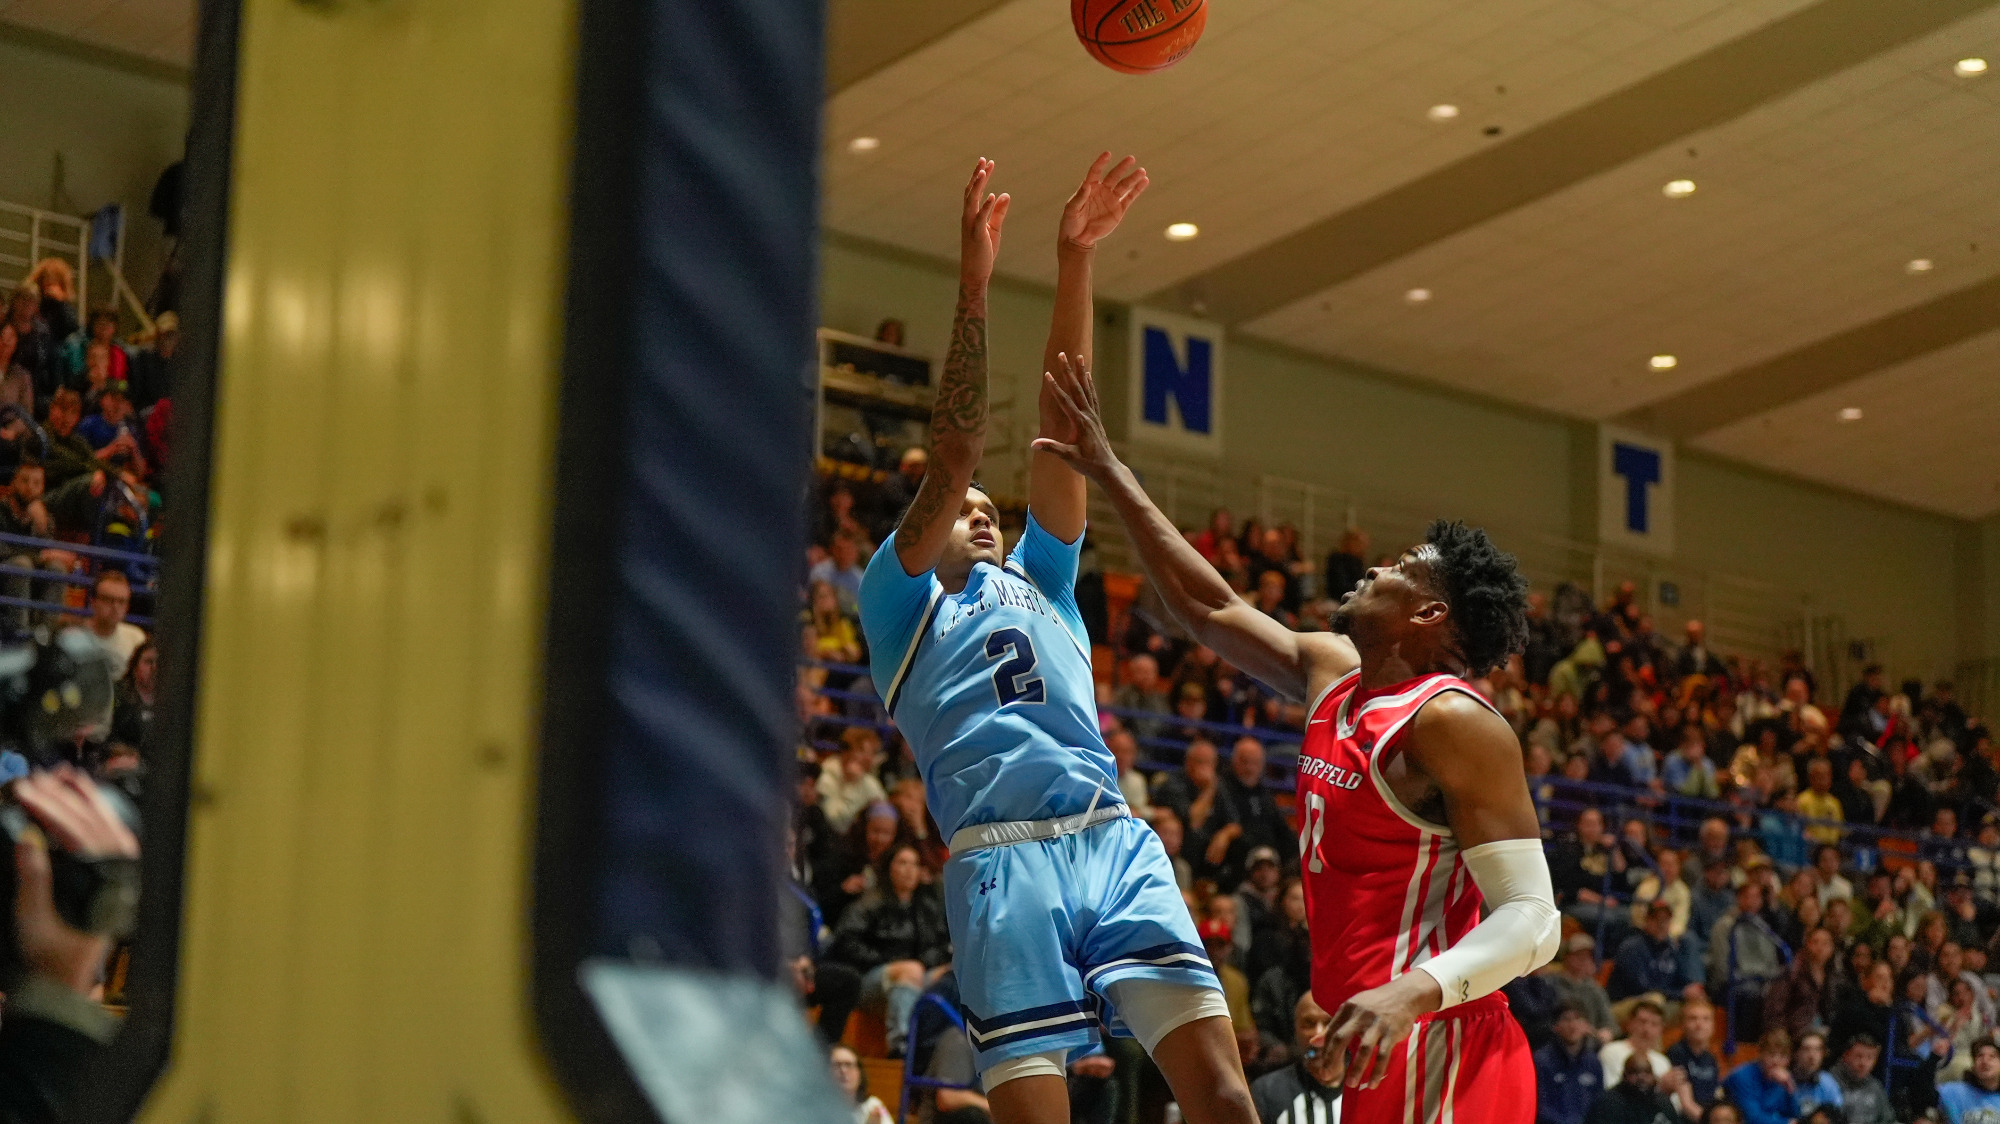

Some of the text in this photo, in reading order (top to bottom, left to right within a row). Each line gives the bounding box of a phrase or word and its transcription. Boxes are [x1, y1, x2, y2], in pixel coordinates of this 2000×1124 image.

[1120, 0, 1166, 33] THE
[1143, 326, 1211, 434] N
[1613, 441, 1660, 534] T
[983, 626, 1047, 707] 2
